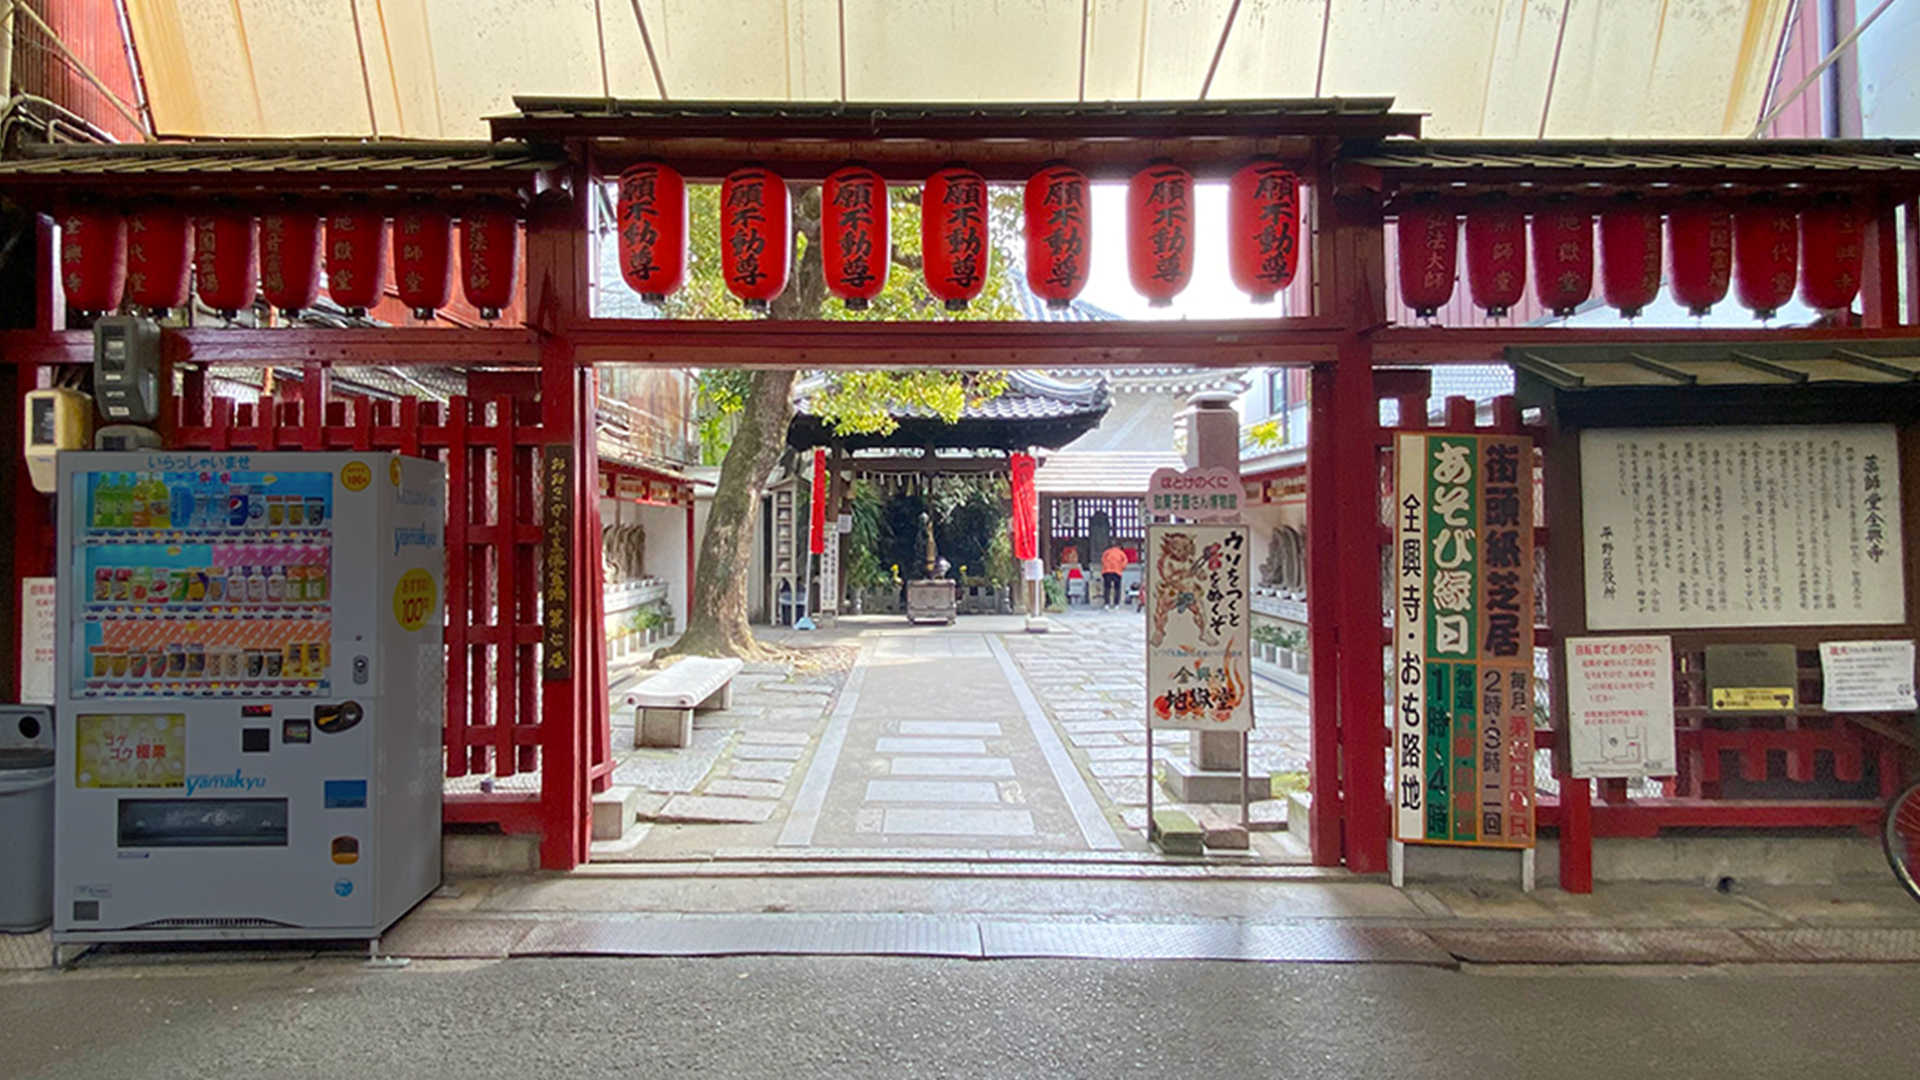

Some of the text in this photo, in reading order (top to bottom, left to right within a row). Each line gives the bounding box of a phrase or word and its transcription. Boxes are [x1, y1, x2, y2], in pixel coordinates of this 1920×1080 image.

[468, 214, 490, 290] 弘法大師
[618, 169, 659, 279] 一願不動尊
[727, 171, 767, 286] 一願不動尊
[832, 171, 876, 286] 一願不動尊
[945, 172, 981, 288] 一願不動尊
[1047, 168, 1084, 286] 一願不動尊
[1146, 166, 1186, 282] 一願不動尊
[1254, 162, 1299, 284] 一願不動尊
[1423, 213, 1447, 289] 弘法大師
[148, 456, 250, 470] いらっしゃいませ
[1153, 493, 1237, 510] 駄菓子屋さん博物館
[1161, 476, 1229, 489] ほとけのくに
[394, 522, 436, 556] yamakyu
[1224, 530, 1244, 627] ウソをつくと
[1431, 441, 1475, 655] あそび縁日
[1484, 443, 1521, 658] 街頭紙芝居
[1599, 526, 1618, 600] 平野区役所
[1207, 542, 1227, 636] 舌をぬくぞ
[1164, 687, 1234, 711] 地獄堂
[1172, 666, 1228, 684] 全興寺
[1401, 494, 1423, 810] 全興寺・おも路地
[186, 769, 266, 796] yamakyu
